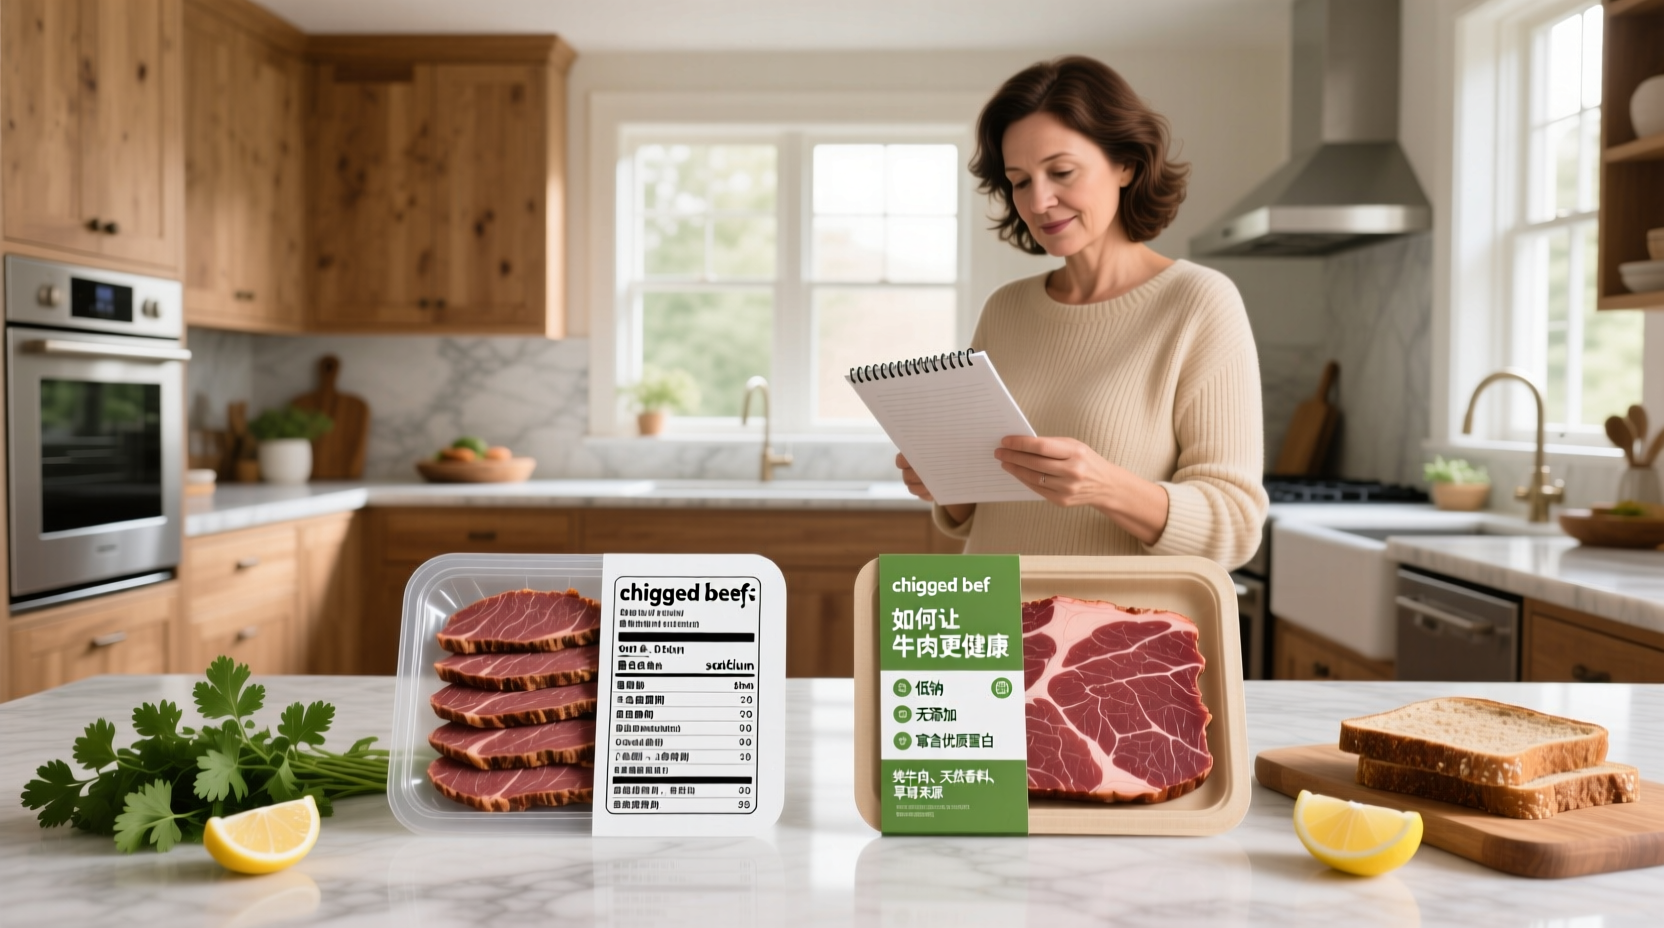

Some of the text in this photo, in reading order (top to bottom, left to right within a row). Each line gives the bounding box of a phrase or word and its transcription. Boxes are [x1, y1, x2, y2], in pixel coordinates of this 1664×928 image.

[620, 582, 700, 607] chigged
[892, 576, 991, 597] chigged bef
[891, 607, 961, 631] 如何让
[892, 633, 1010, 659] 牛肉更健康
[915, 679, 944, 697] 低钠
